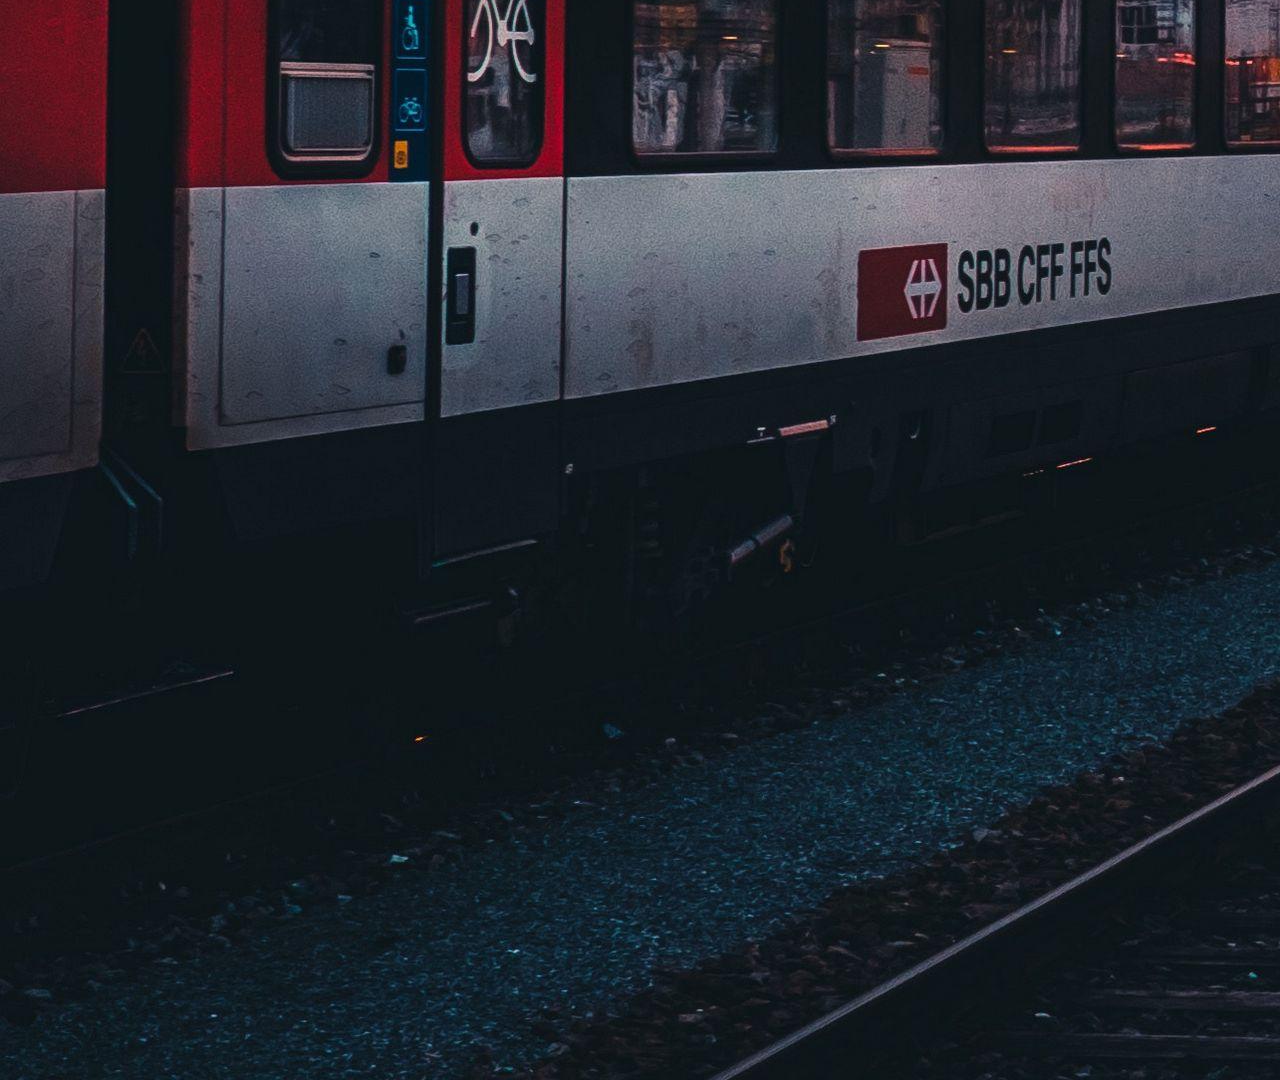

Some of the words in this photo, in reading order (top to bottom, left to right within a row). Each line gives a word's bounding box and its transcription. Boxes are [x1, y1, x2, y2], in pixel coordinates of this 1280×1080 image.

[957, 249, 1011, 313] SBB
[1018, 243, 1064, 306] CFF
[1069, 236, 1112, 298] FFS
